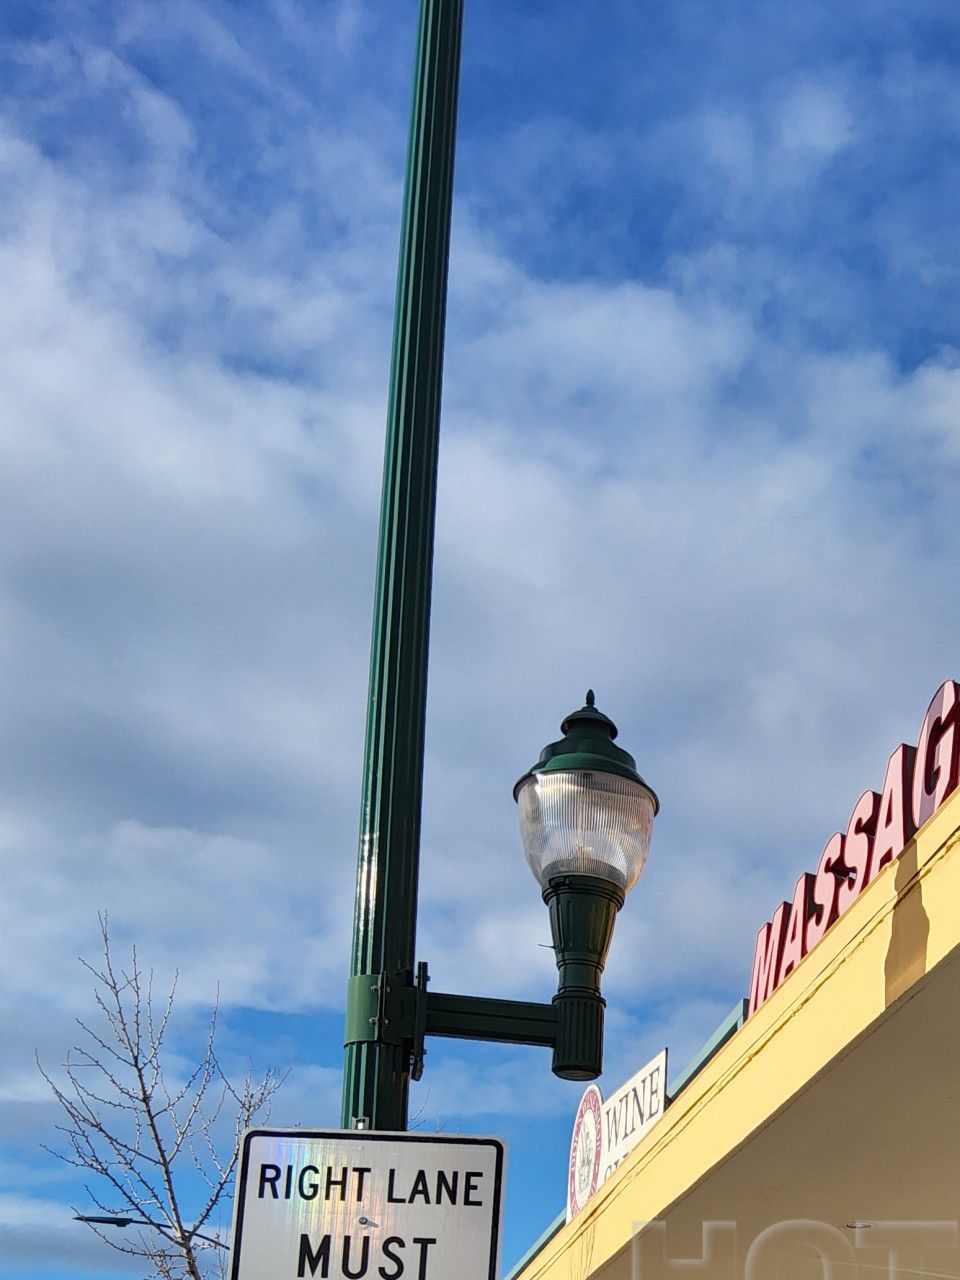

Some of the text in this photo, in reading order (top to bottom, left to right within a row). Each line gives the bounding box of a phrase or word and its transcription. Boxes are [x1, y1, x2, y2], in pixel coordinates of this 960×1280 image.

[605, 1066, 661, 1153] WINE
[258, 1163, 483, 1206] RIGHT LANE
